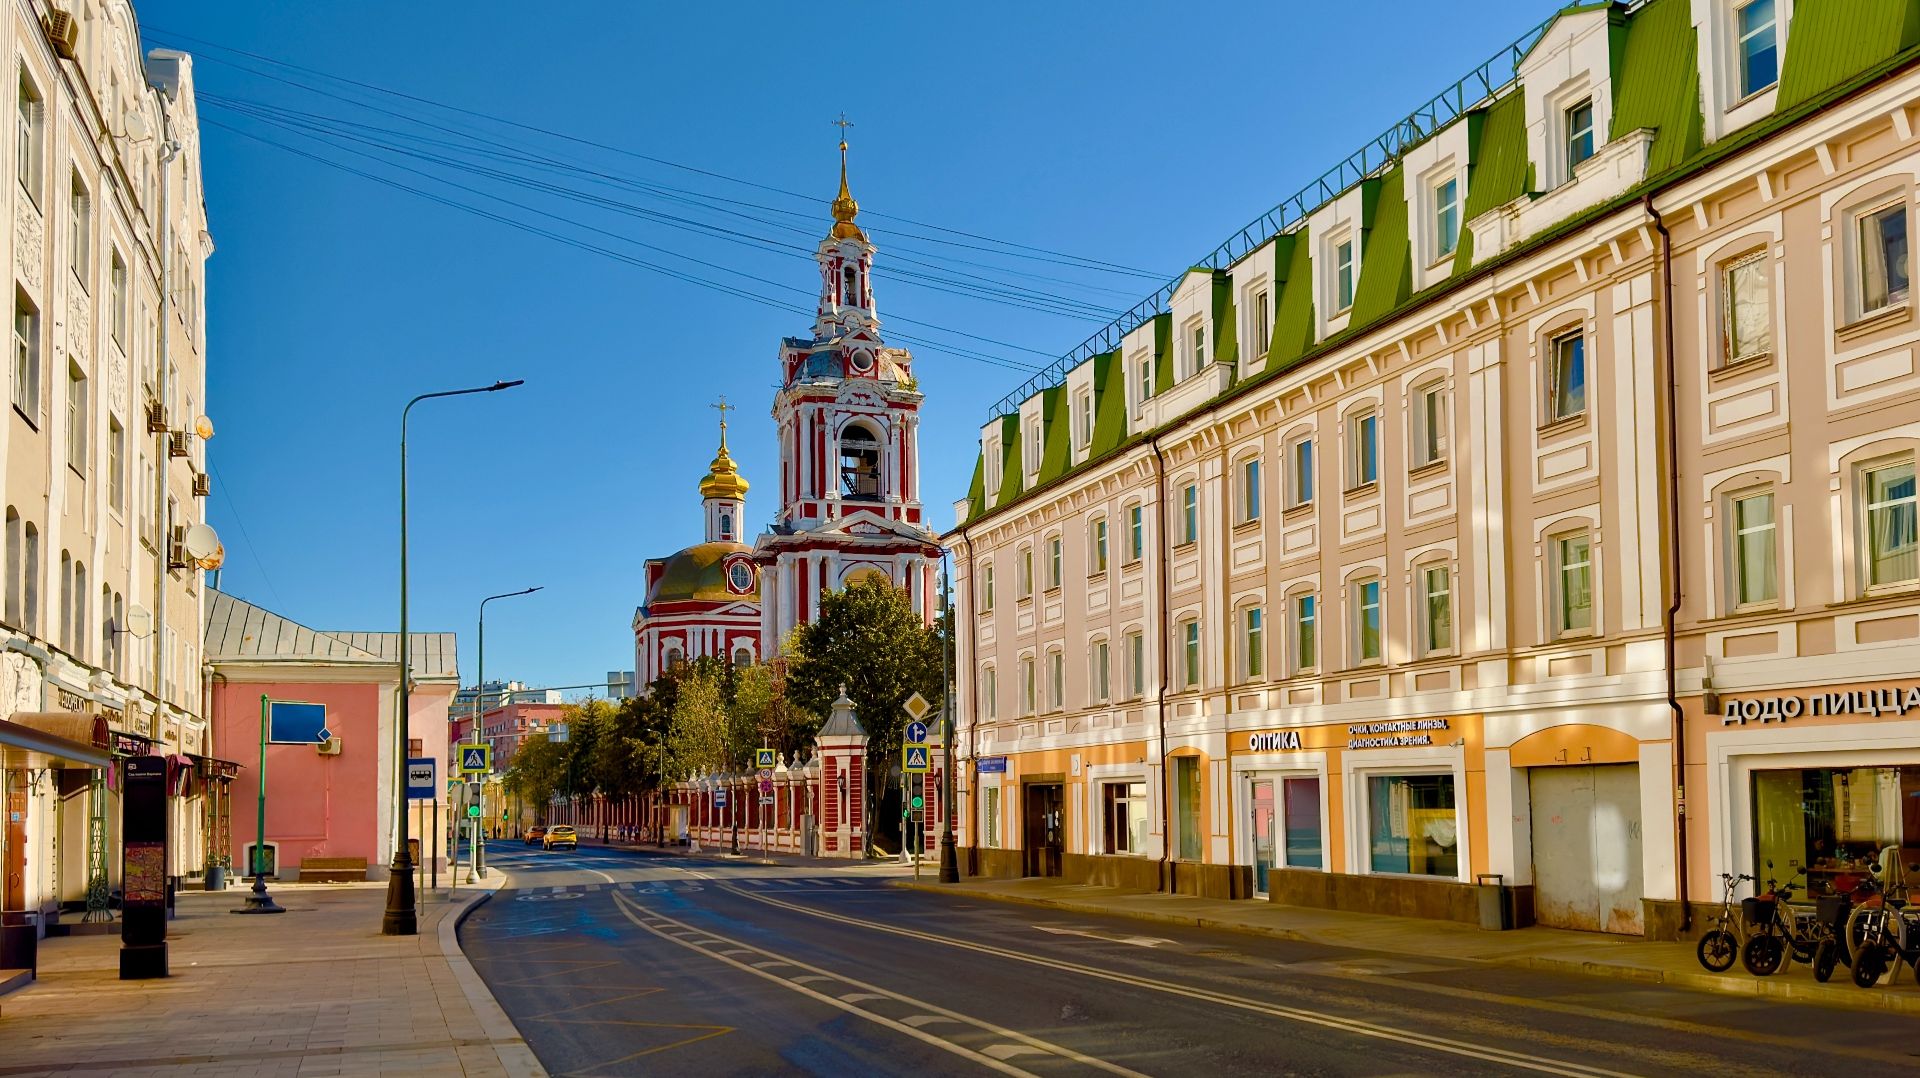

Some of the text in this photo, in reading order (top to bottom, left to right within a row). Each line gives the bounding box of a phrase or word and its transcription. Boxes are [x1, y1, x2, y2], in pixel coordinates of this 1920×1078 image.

[1721, 687, 1920, 726] ДОДО ПИЦЦА
[1348, 719, 1447, 734] ОЧКИ, КОНТАКТНЫЕ ЛИНЗЫ,
[1249, 731, 1299, 751] ОПТИКА
[1348, 735, 1430, 749] ДИАГНОСТИКА ЗРЕНИЯ.
